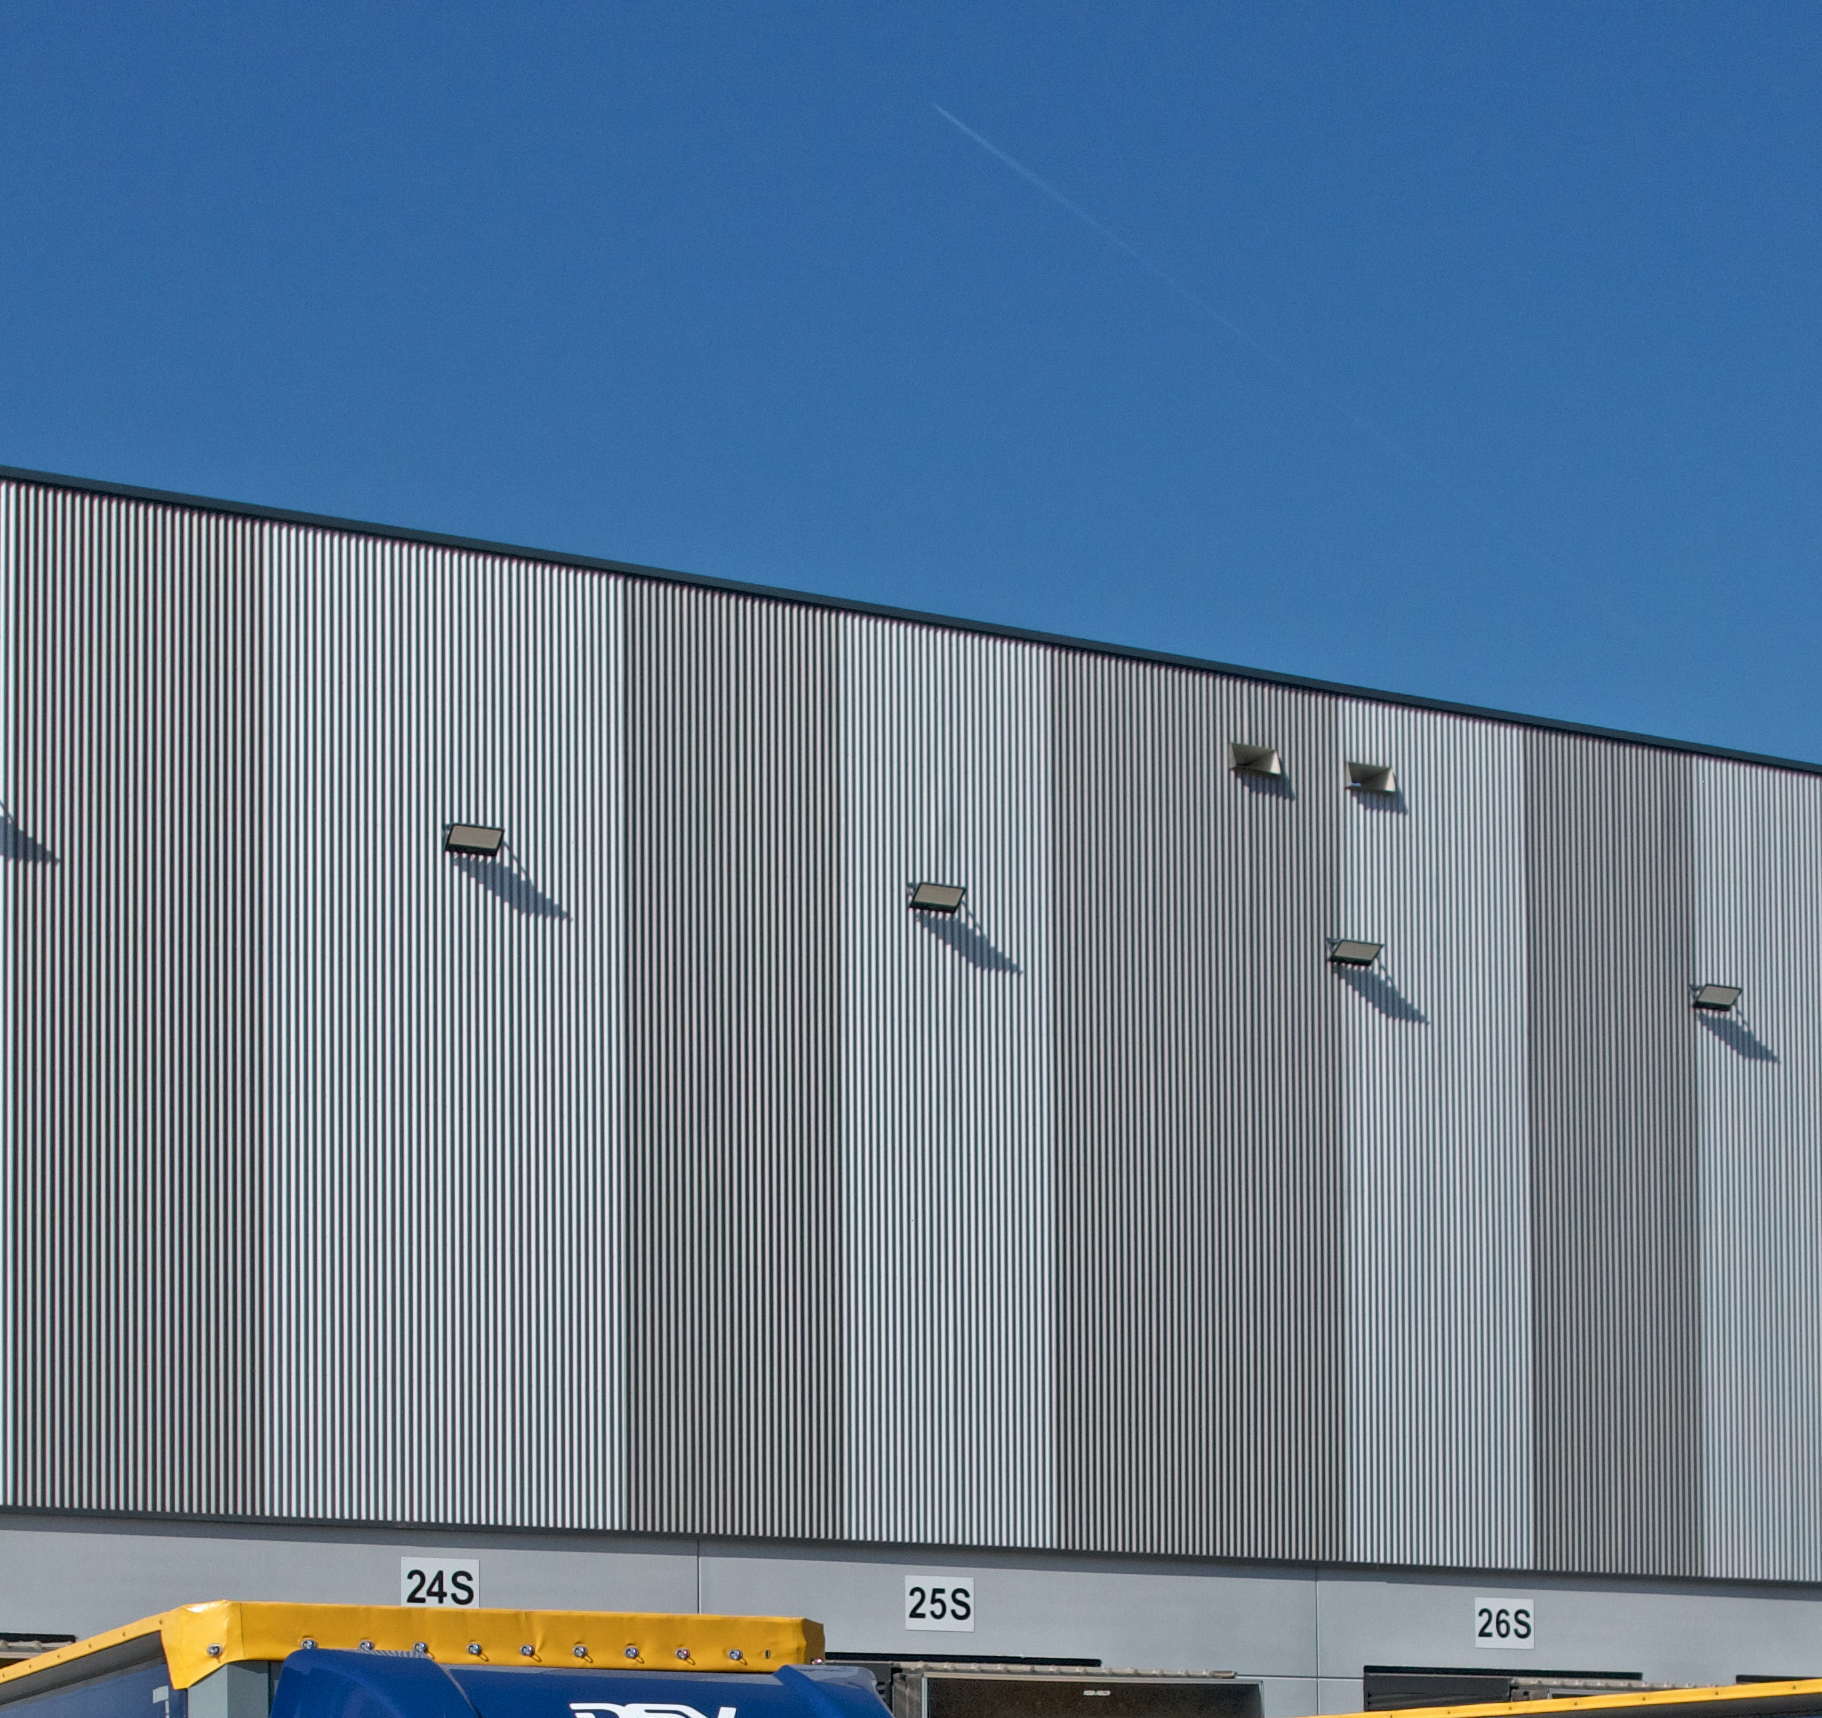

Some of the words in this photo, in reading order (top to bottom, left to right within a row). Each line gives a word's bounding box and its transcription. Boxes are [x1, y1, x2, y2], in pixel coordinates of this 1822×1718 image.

[407, 1569, 474, 1605] 24S
[908, 1586, 971, 1621] 25S
[1478, 1607, 1532, 1639] 26S
